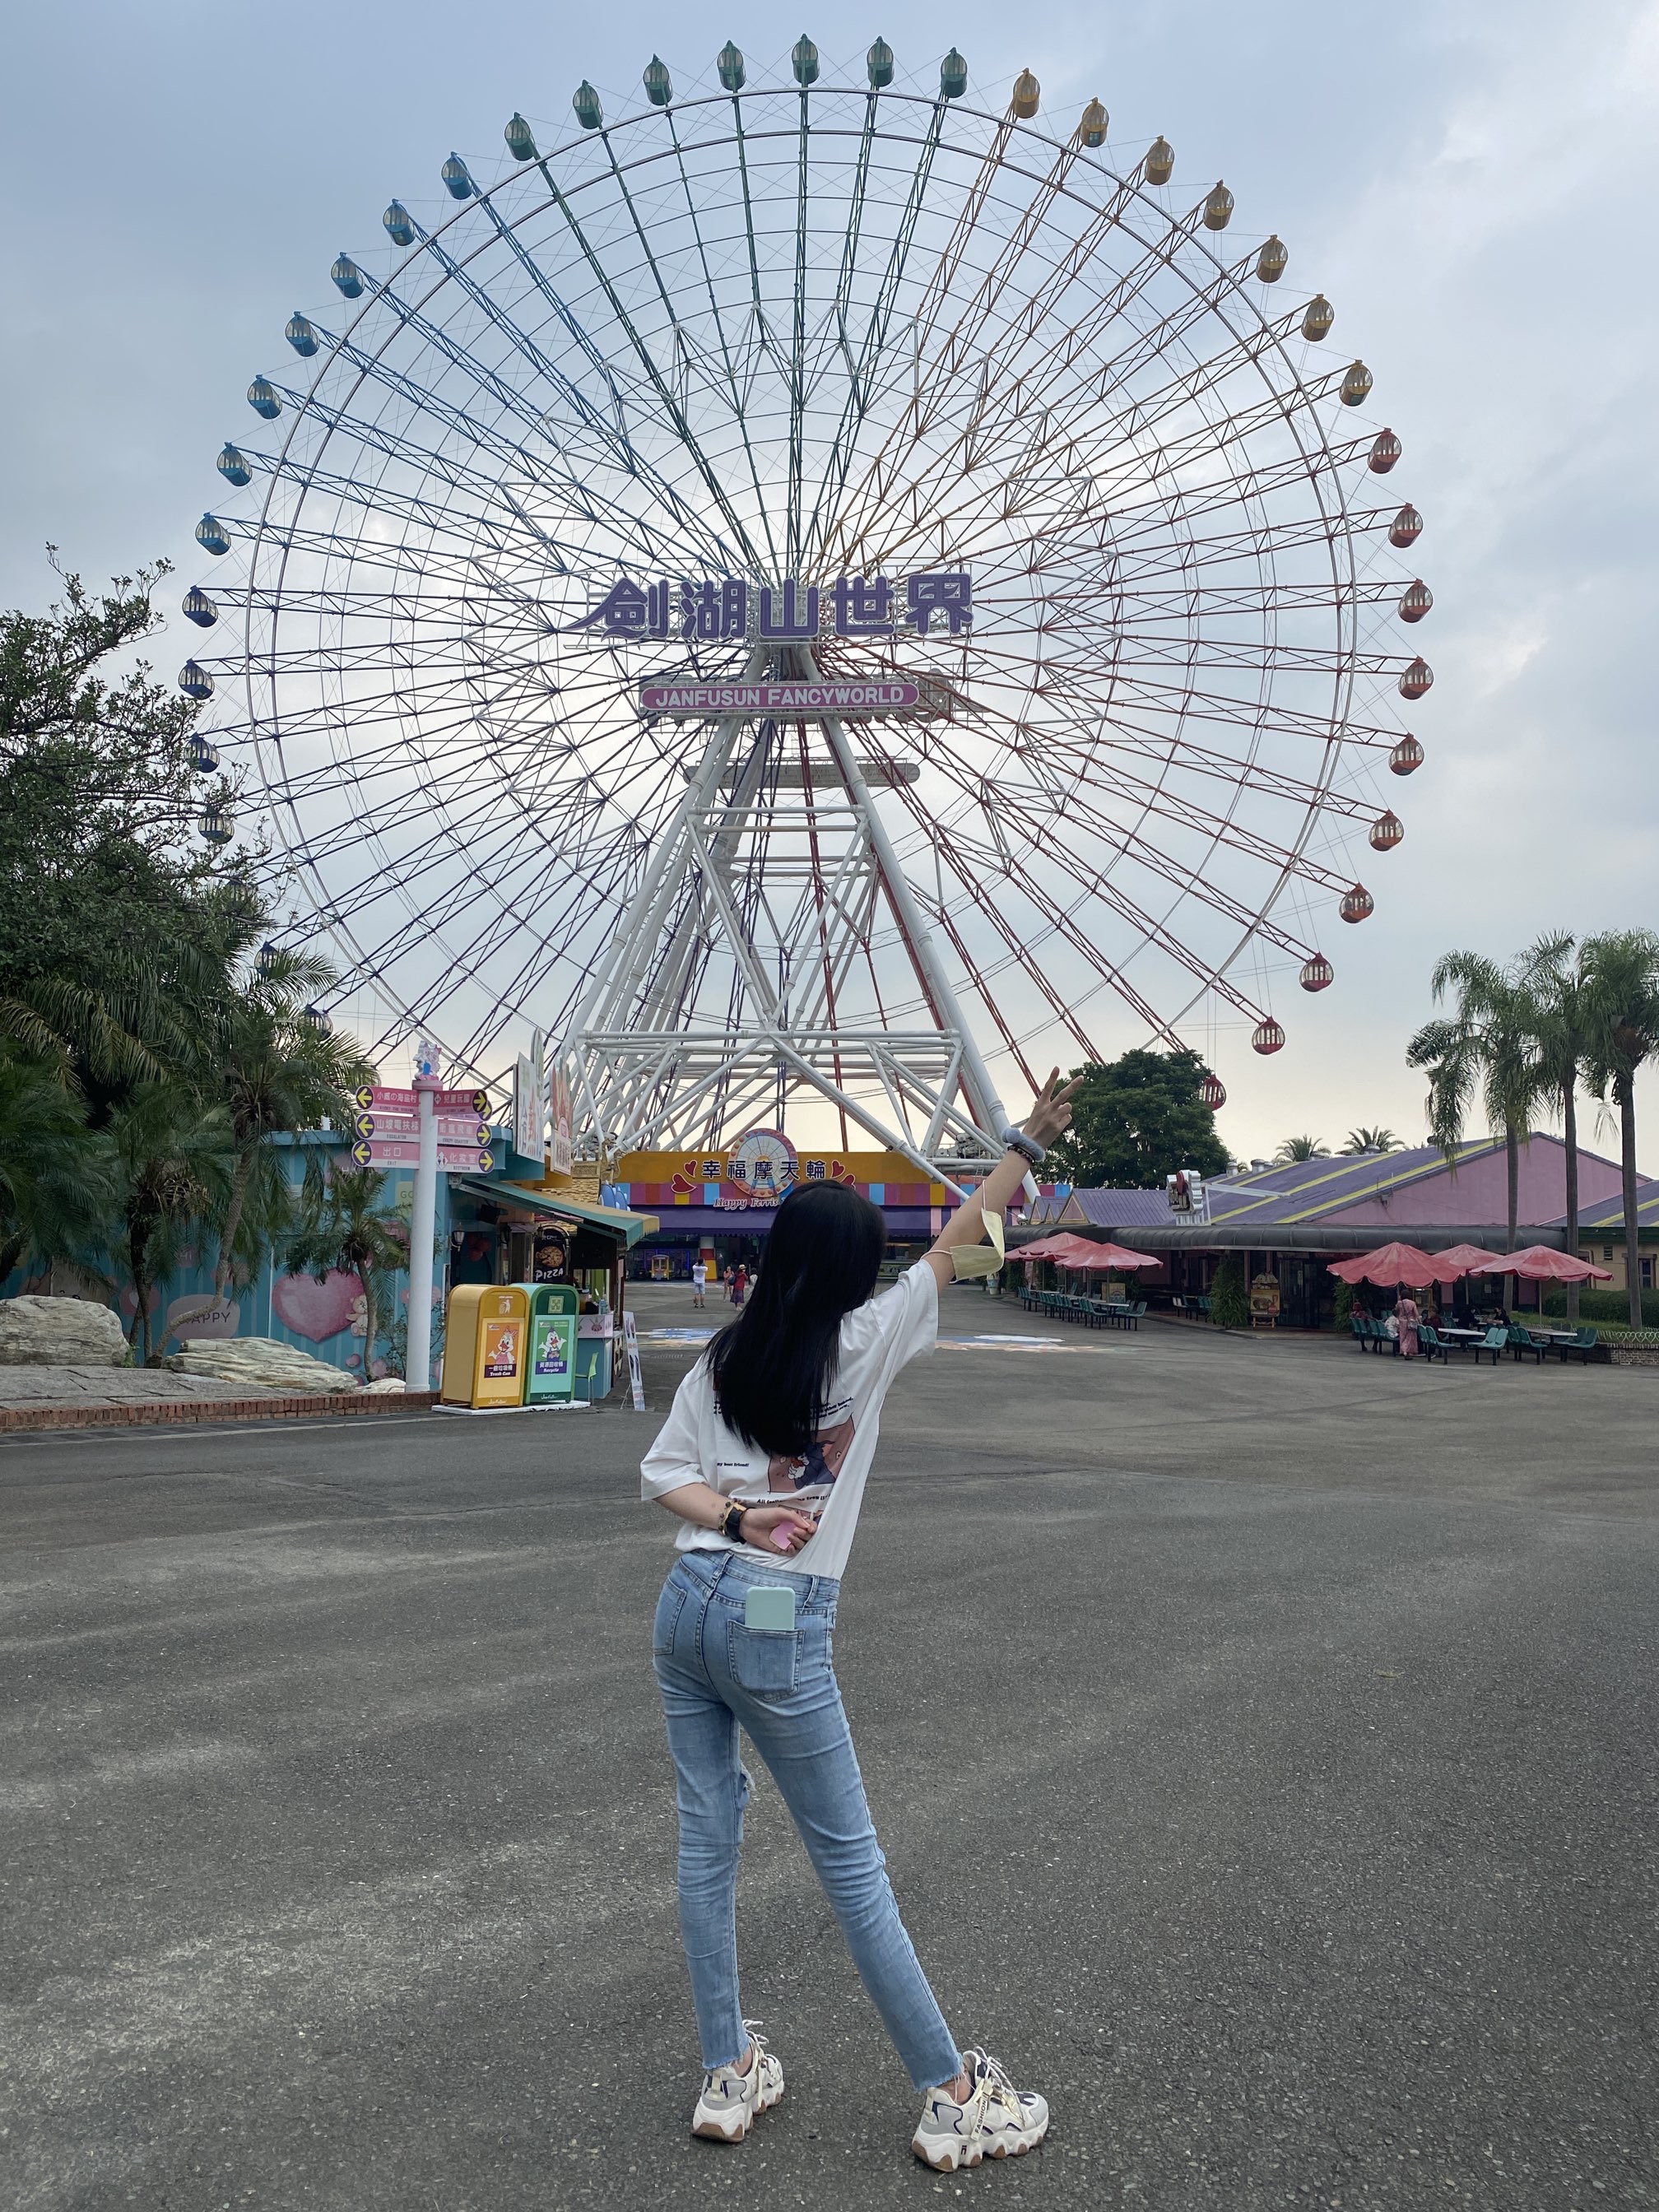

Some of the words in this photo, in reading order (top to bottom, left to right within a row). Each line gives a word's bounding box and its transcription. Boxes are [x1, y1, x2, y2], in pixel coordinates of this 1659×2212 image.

[559, 573, 974, 642] 劍湖山世界
[656, 689, 760, 708] JANFUSUN
[767, 685, 904, 706] FANCYWORLD
[377, 1119, 419, 1131] 山坡電扶梯
[383, 1146, 402, 1157] 出口
[702, 1159, 827, 1180] 幸福摩天輪
[713, 1197, 748, 1211] Happy
[750, 1197, 779, 1208] Ferris
[535, 1267, 564, 1281] PIZZA
[189, 1312, 231, 1324] APPY
[974, 2099, 988, 2134] FASHION
